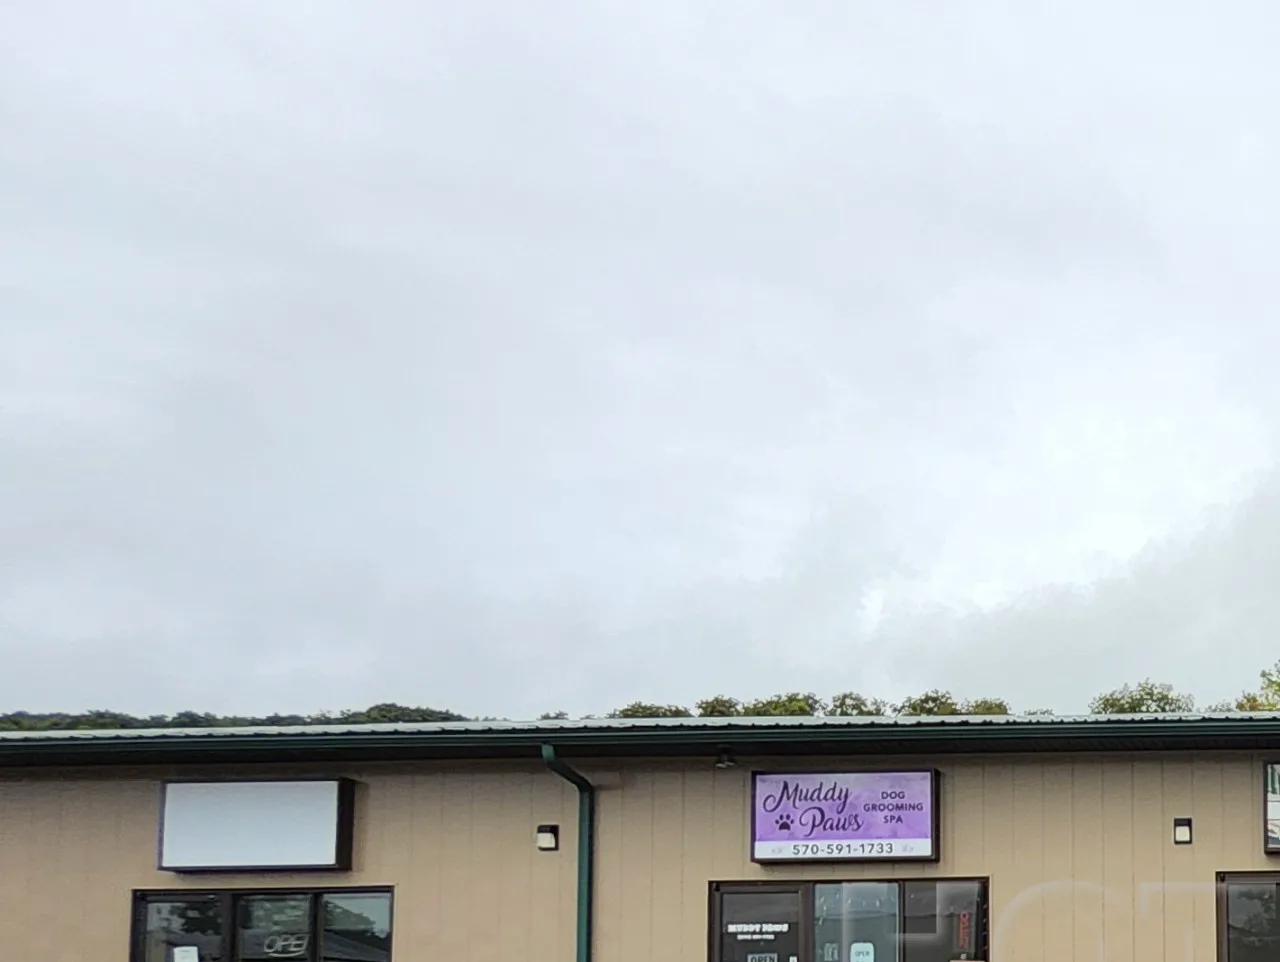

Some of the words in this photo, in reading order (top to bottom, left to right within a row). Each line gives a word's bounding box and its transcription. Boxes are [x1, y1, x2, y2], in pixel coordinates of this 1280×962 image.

[763, 780, 851, 814] Muddy
[881, 791, 905, 800] DOG
[863, 802, 924, 812] GROOMING
[799, 806, 864, 837] Paws
[883, 815, 904, 824] SPA
[792, 843, 894, 855] 570-591-1733
